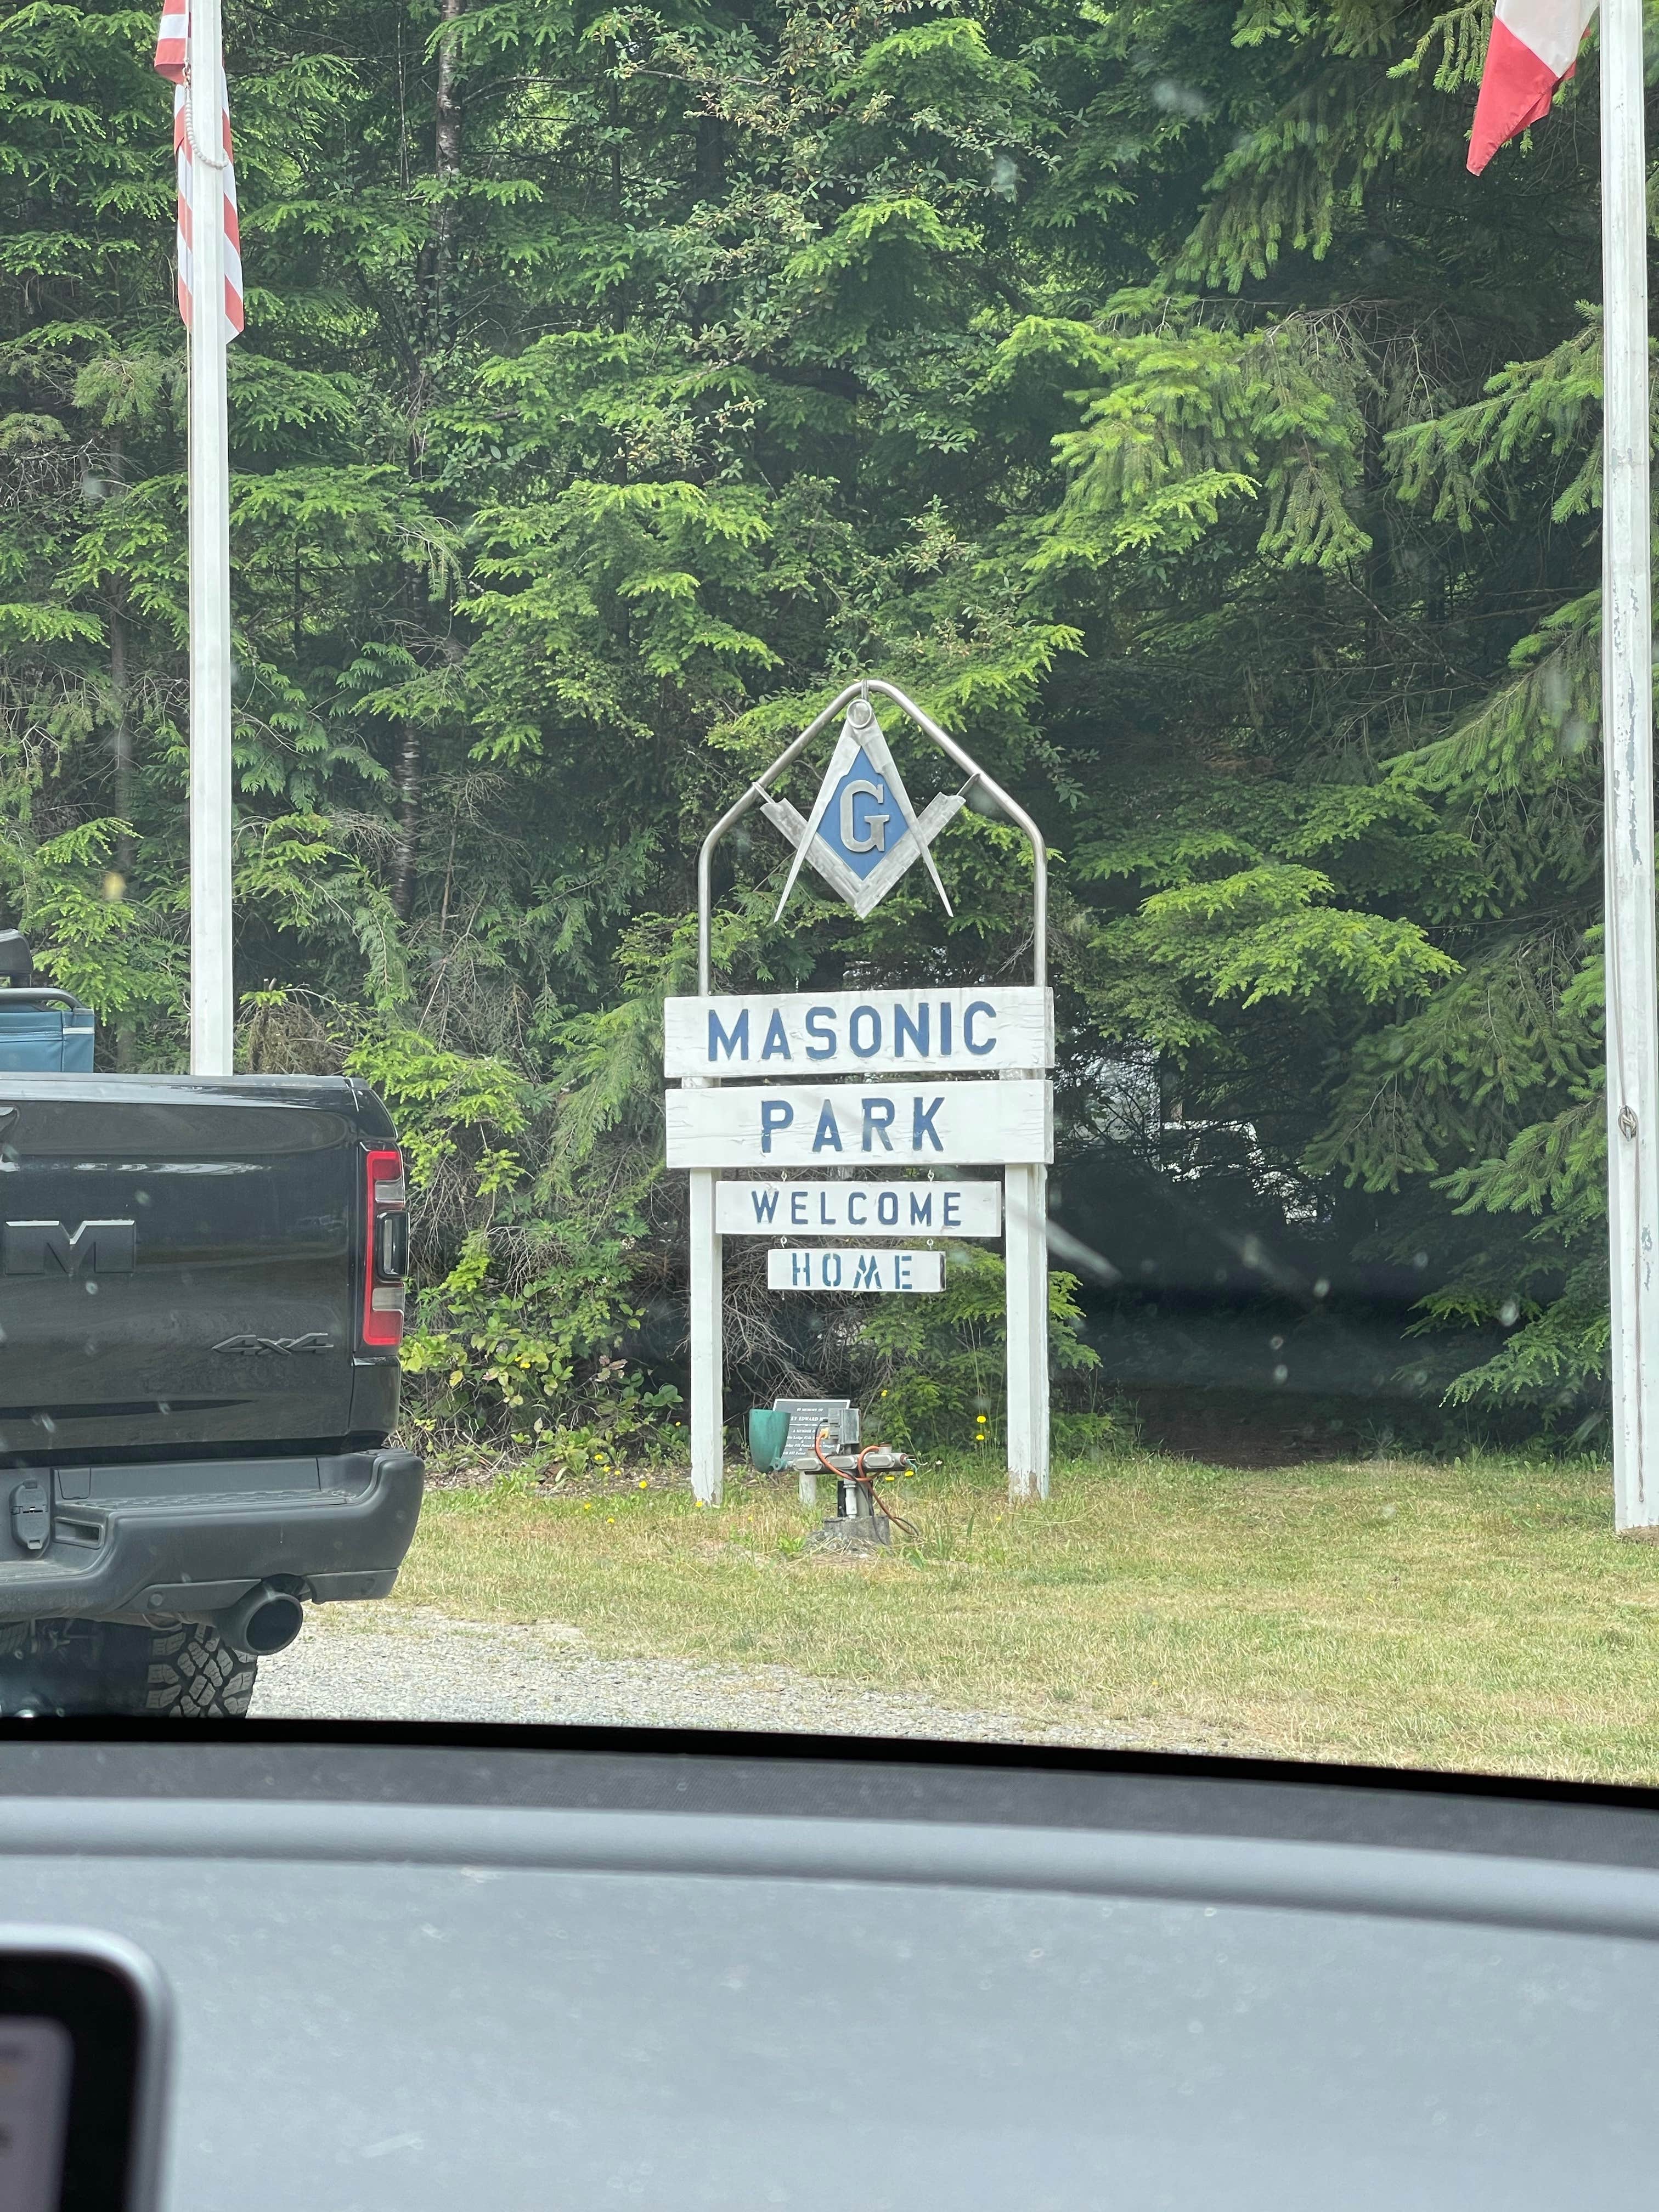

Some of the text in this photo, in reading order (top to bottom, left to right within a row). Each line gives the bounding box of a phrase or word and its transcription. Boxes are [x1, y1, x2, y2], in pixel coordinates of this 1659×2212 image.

[839, 779, 890, 853] G
[707, 1000, 997, 1062] MASONIC
[760, 1097, 945, 1154] PARK
[751, 1190, 962, 1227] WELCOME
[791, 1252, 913, 1290] HOME
